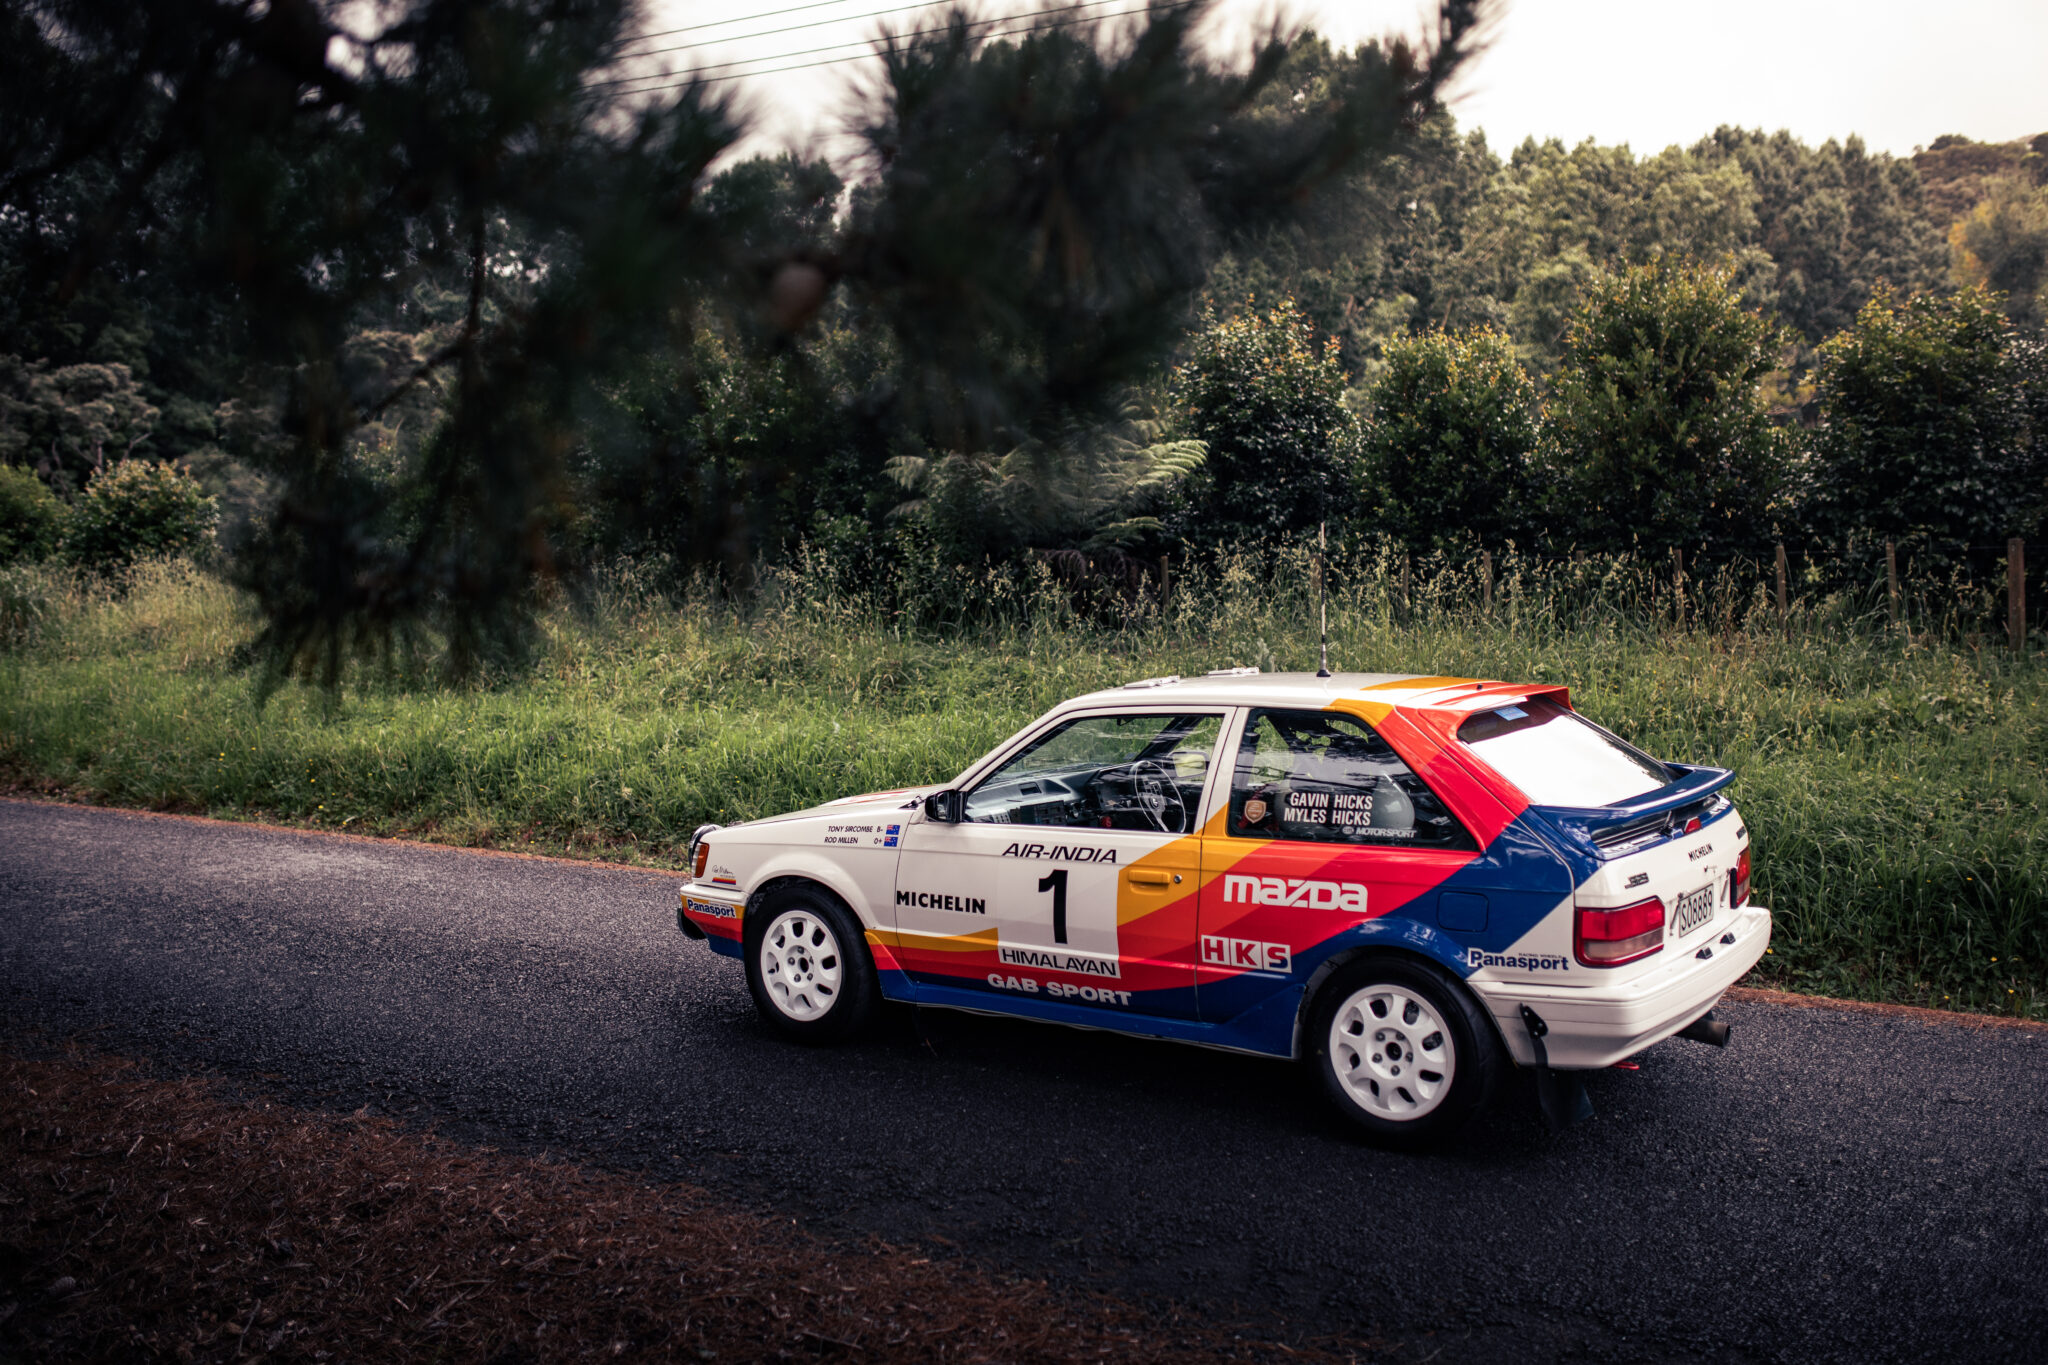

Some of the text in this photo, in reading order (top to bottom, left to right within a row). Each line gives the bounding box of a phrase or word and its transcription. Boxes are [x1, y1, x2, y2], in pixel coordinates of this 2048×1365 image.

[1290, 792, 1373, 810] GAVIN HICKS
[1284, 808, 1327, 824] MYLES
[1331, 809, 1371, 826] HICKS
[828, 825, 844, 833] TONY
[1355, 827, 1417, 839] MOTORSPORT
[824, 836, 837, 844] ROD
[837, 836, 858, 844] MILLEN
[1002, 842, 1117, 864] AIR-INDIA
[1687, 843, 1713, 862] MICHELIN
[687, 898, 736, 918] Panasport
[896, 890, 986, 915] MICHELIN
[1038, 869, 1068, 944] 1
[1002, 948, 1117, 976] HIMALAYAN
[1203, 936, 1290, 971] HKS
[1470, 950, 1569, 972] Panasport
[987, 973, 1132, 1006] GAB SPORT
